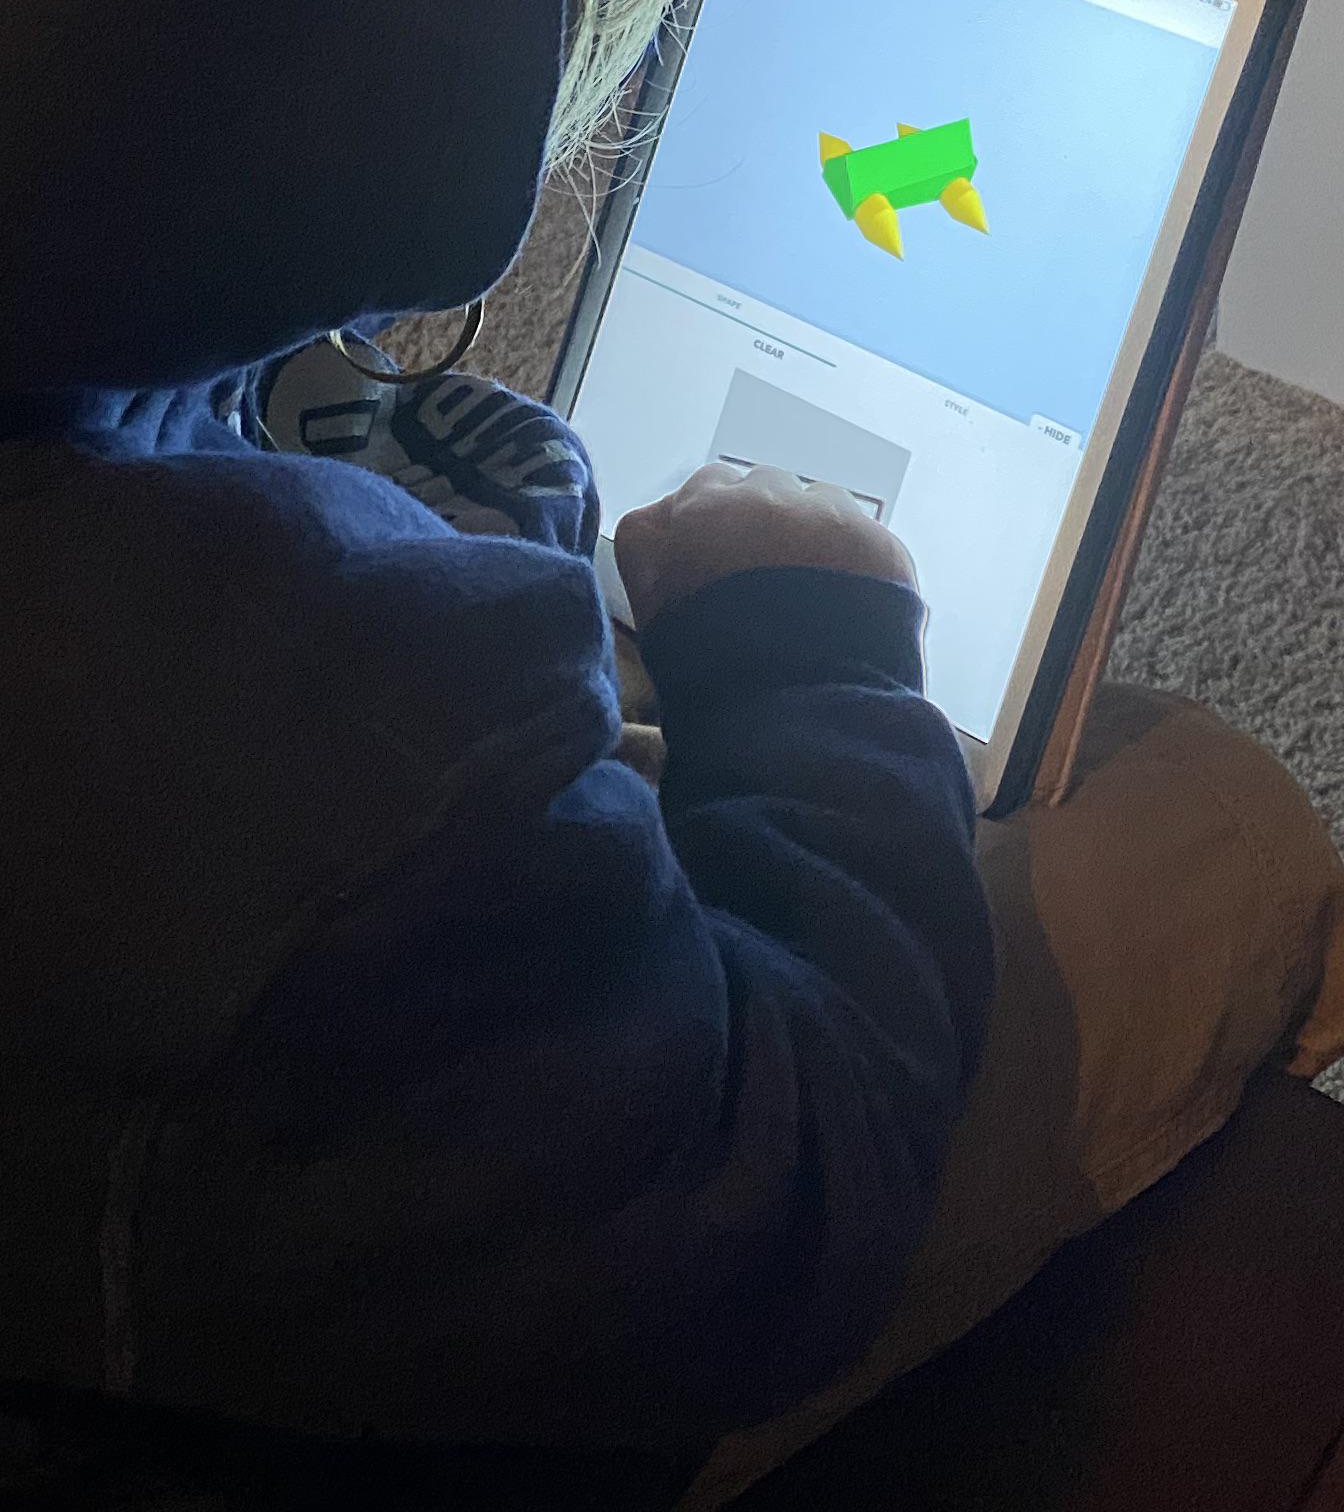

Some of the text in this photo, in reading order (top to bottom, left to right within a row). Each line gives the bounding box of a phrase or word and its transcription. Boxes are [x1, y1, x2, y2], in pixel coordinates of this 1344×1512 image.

[753, 339, 785, 360] CLEAR
[944, 399, 969, 417] STYLE
[1043, 425, 1072, 445] HIDE
